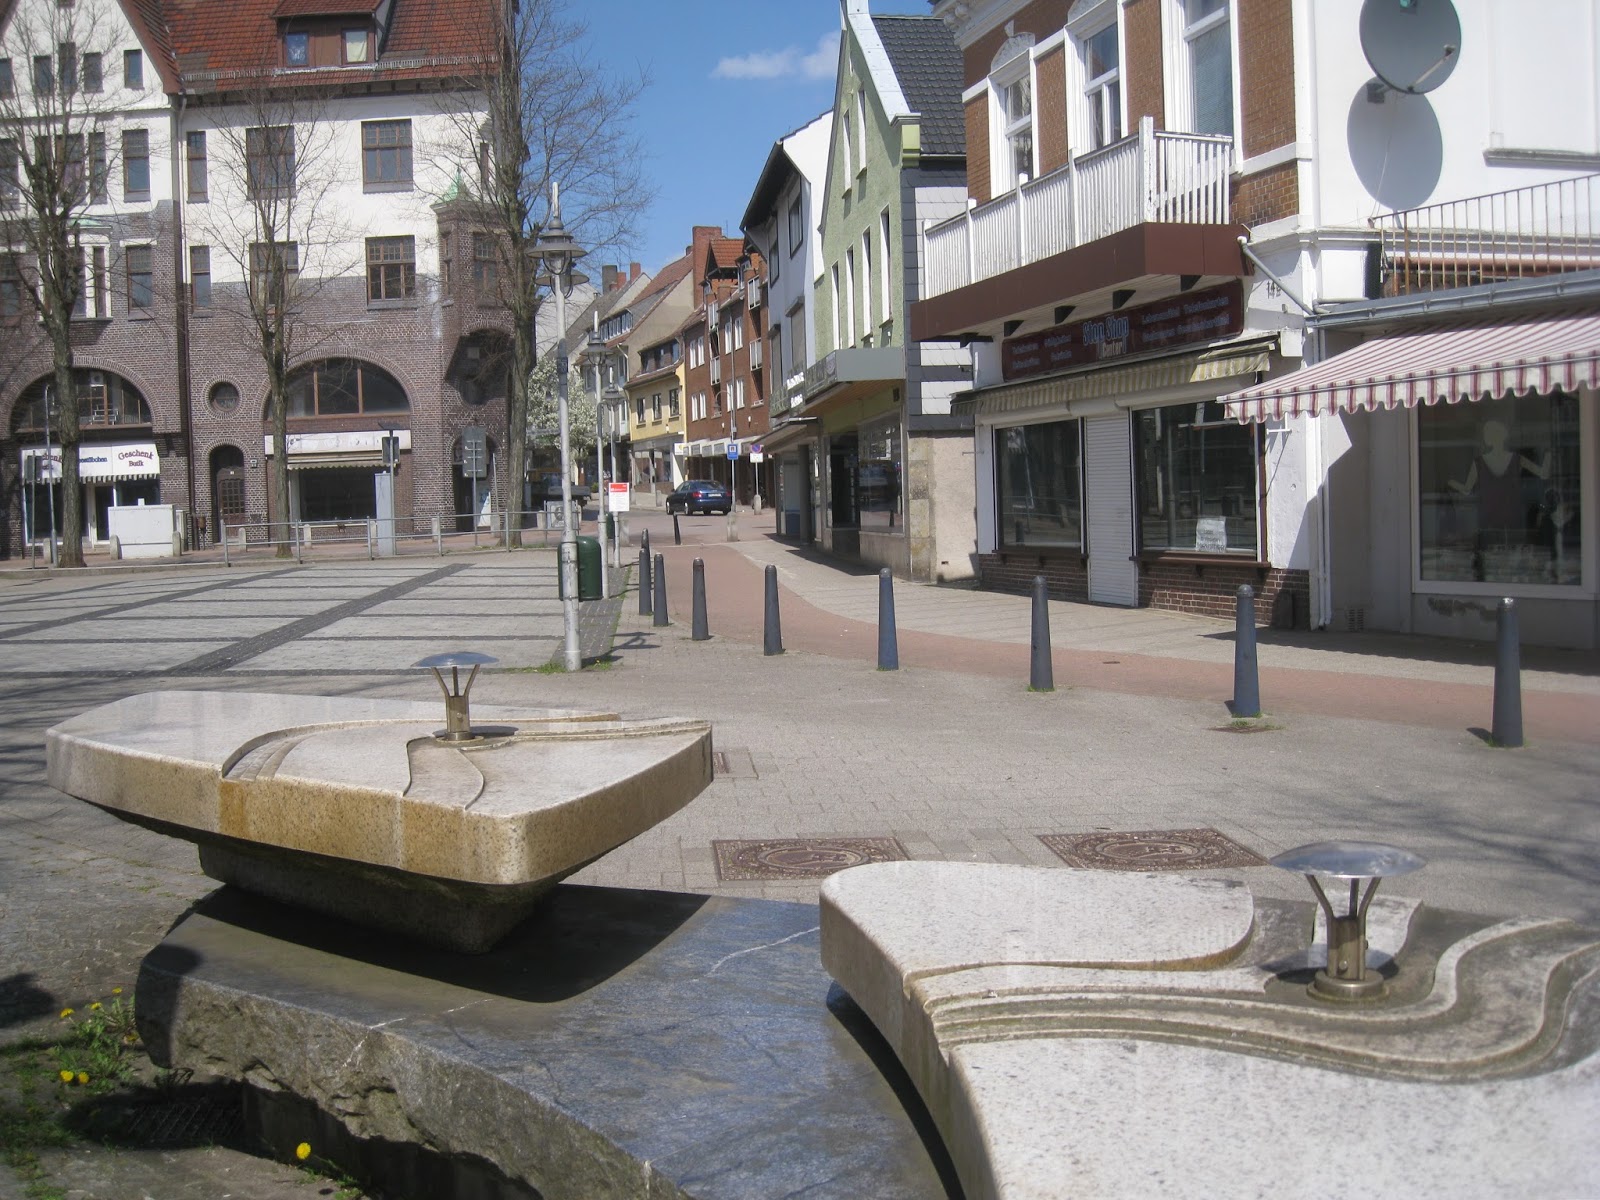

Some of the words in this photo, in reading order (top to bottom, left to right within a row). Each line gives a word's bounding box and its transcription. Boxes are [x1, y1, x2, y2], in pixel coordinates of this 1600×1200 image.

[1083, 320, 1105, 359] Stop
[1105, 314, 1129, 354] Shop
[118, 448, 154, 460] Geschenk
